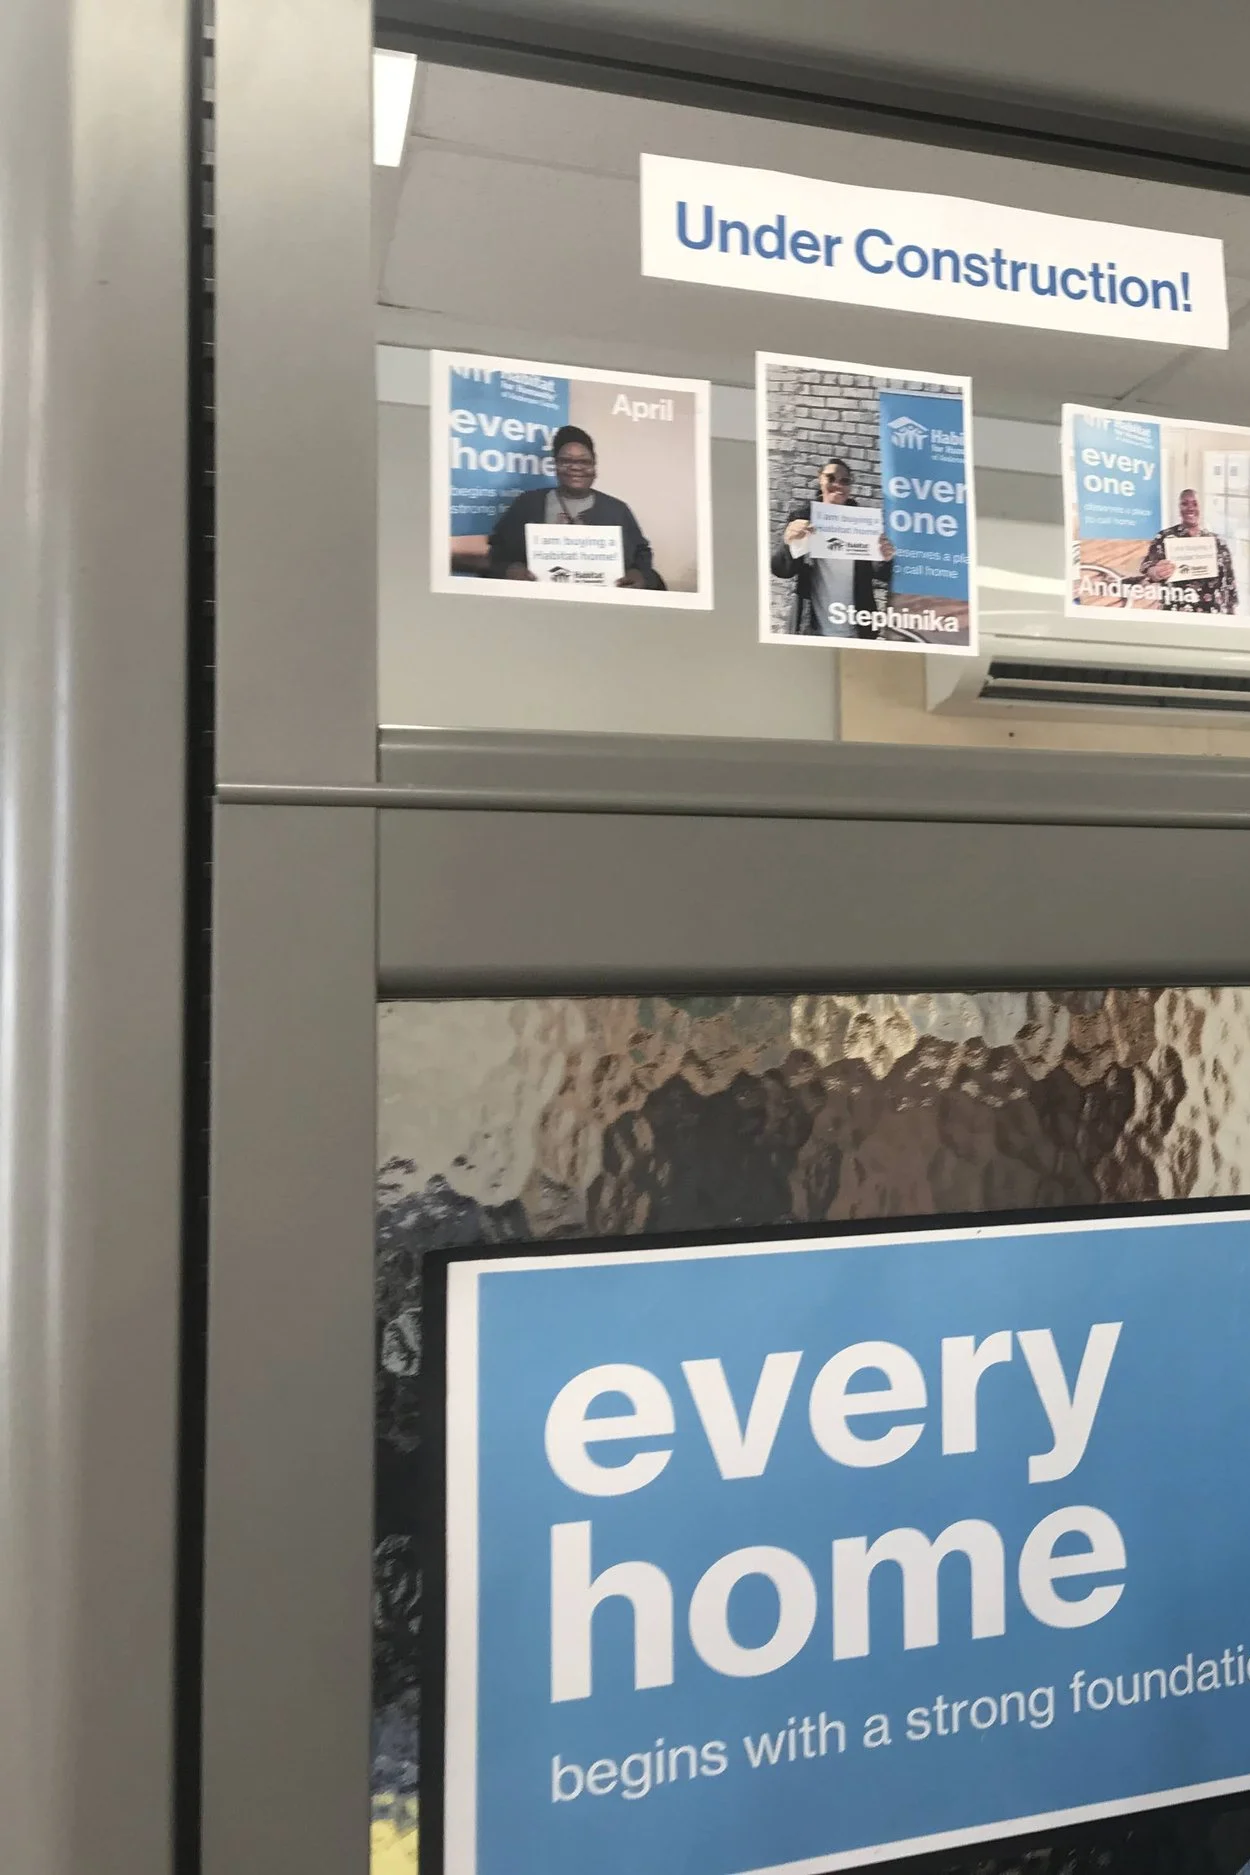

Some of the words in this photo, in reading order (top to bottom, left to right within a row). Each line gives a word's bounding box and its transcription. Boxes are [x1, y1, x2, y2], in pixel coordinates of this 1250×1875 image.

[676, 201, 842, 267] Under
[855, 228, 1192, 313] Construction!
[612, 394, 674, 422] April
[450, 409, 558, 451] every
[450, 437, 557, 477] home
[1081, 447, 1155, 480] every
[888, 475, 968, 504] ever
[1083, 474, 1135, 497] one
[889, 509, 959, 537] one
[895, 548, 942, 561] eserves
[903, 564, 923, 576] call
[924, 565, 959, 579] home
[1080, 576, 1201, 604] Andreanna
[828, 602, 959, 633] Stephinika
[543, 1321, 1122, 1497] every
[550, 1504, 1128, 1704] home
[550, 1740, 728, 1803] begins
[744, 1711, 846, 1767] with
[863, 1713, 891, 1748] a
[905, 1687, 1054, 1741] strong
